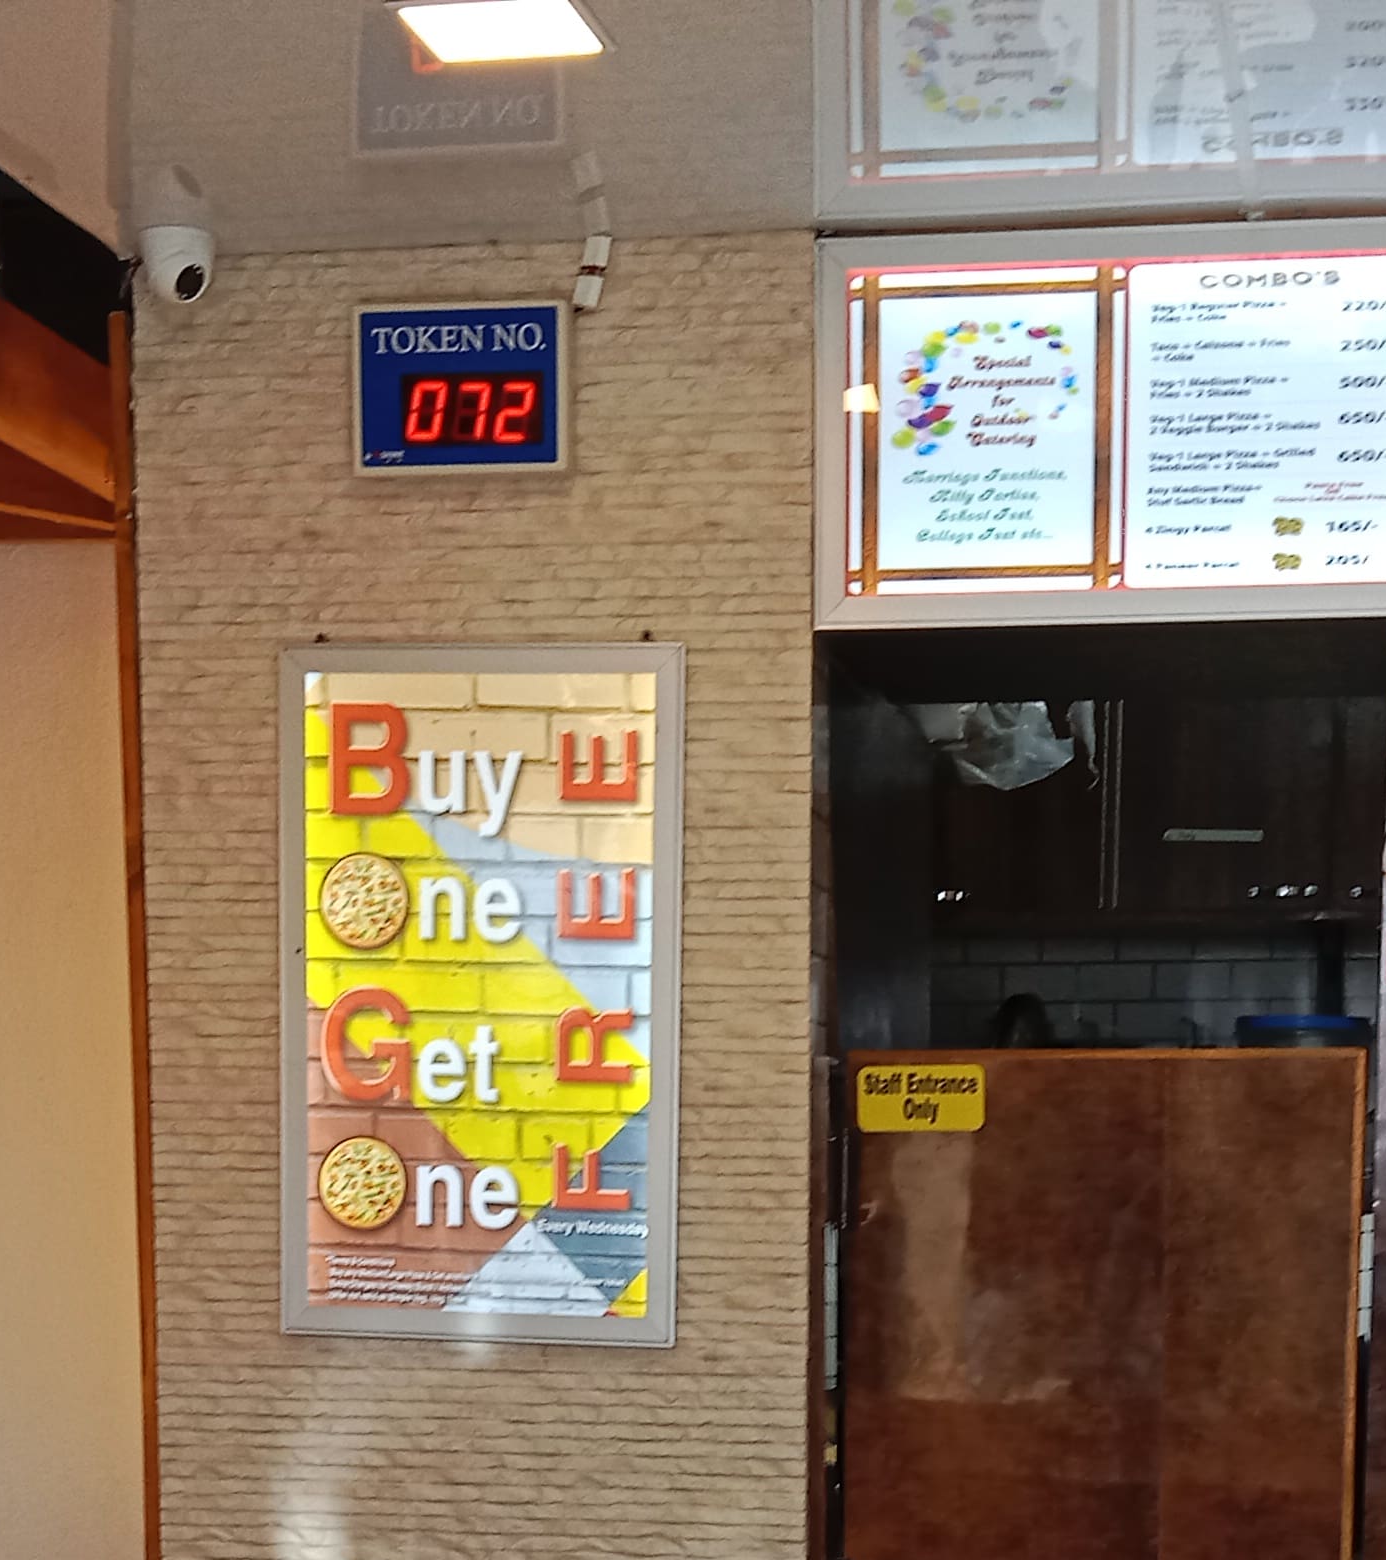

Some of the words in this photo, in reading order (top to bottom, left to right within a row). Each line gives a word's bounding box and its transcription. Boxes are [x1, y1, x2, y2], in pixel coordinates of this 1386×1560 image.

[1200, 270, 1341, 288] COMBO'S
[371, 323, 485, 355] TOKEN
[492, 322, 547, 352] NO.
[405, 380, 536, 444] 072
[328, 703, 522, 838] Buy
[321, 984, 500, 1104] Get
[864, 1072, 902, 1095] Staff
[907, 1072, 978, 1095] Entrance
[903, 1097, 940, 1125] Only
[537, 1219, 575, 1237] Every
[576, 1219, 649, 1239] Wednesday
